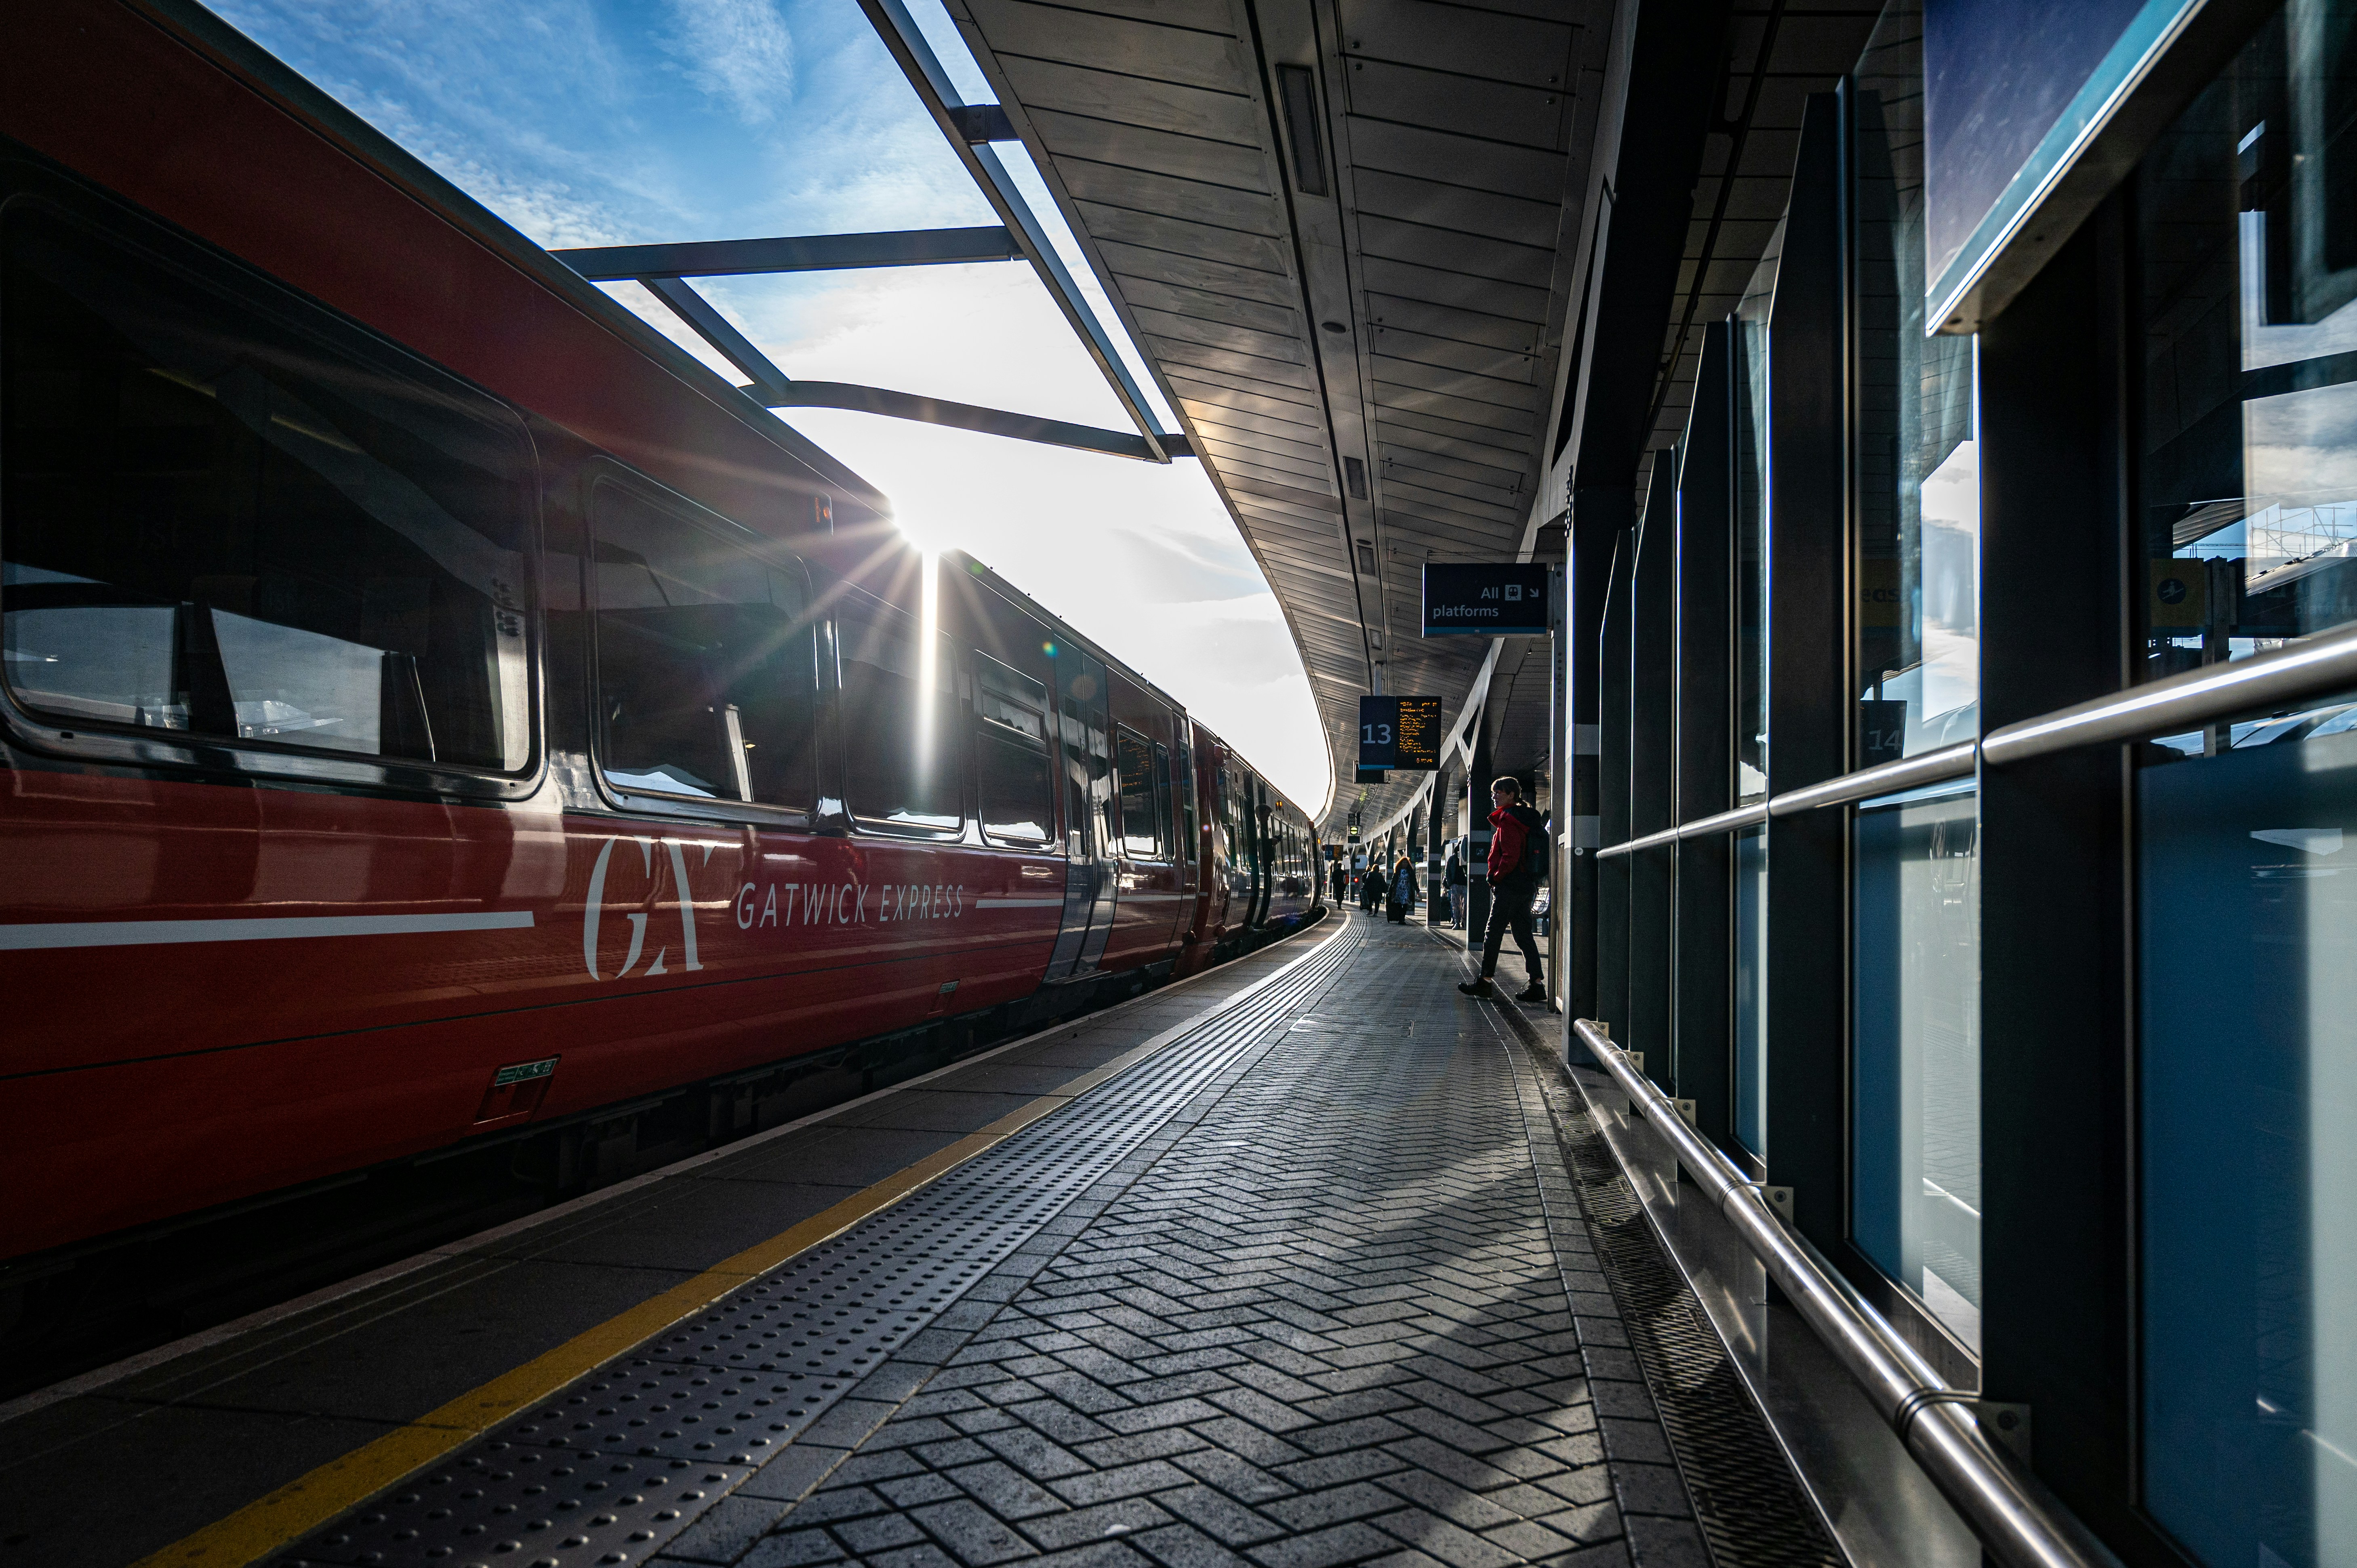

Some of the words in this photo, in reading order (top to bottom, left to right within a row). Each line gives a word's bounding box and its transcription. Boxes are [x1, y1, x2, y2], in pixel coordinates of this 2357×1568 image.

[1481, 587, 1498, 599] All
[1433, 605, 1499, 619] platforms
[1362, 724, 1391, 744] 13
[1868, 729, 1901, 750] 14
[583, 834, 718, 981] GX
[737, 882, 871, 930] GATWICK
[879, 884, 964, 922] EXPRESS
